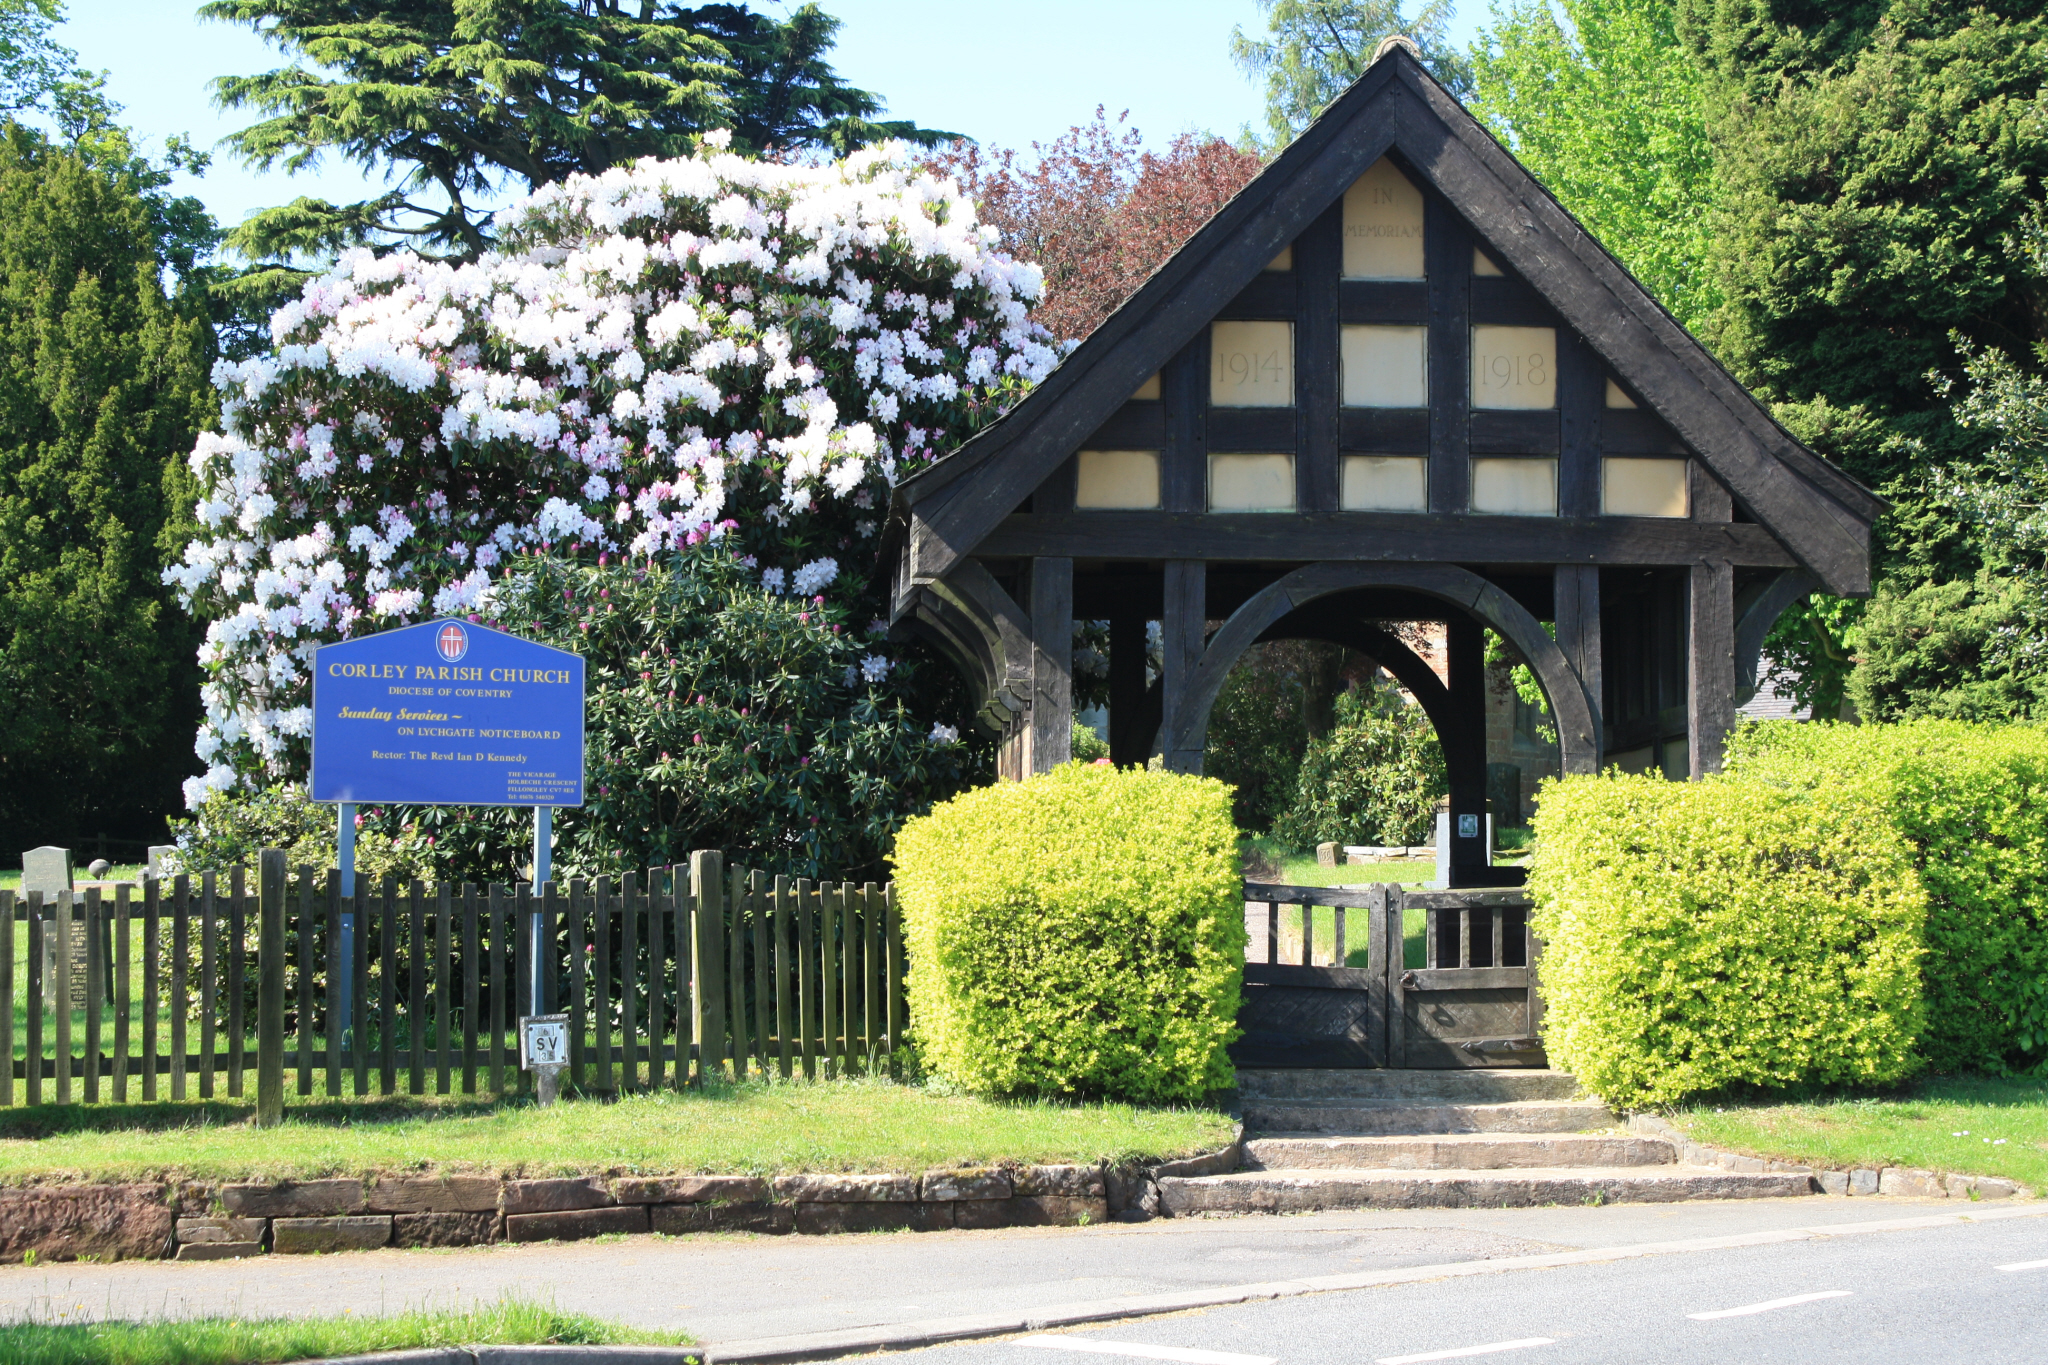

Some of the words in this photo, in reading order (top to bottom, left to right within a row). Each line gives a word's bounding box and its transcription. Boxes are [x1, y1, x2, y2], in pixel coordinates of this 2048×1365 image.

[1218, 349, 1284, 385] 1914
[1481, 353, 1546, 389] 1918
[328, 662, 408, 679] CORLEY
[415, 666, 483, 681] PARISH
[490, 668, 571, 684] CHURCH
[388, 686, 434, 696] DIOCESE
[437, 687, 453, 697] OF
[455, 688, 513, 698] COVENTRY
[338, 706, 392, 722] Sunday
[396, 708, 449, 721] Services
[397, 726, 415, 736] ON
[418, 727, 476, 738] LYCHGATE
[479, 729, 561, 740] NOTICEBOARD
[372, 750, 406, 760] Rector:
[409, 751, 427, 760] The
[431, 751, 454, 761] Revd
[457, 752, 472, 761] Ian
[475, 752, 484, 761] D
[487, 752, 528, 764] Kennedy
[536, 1037, 558, 1051] SV
